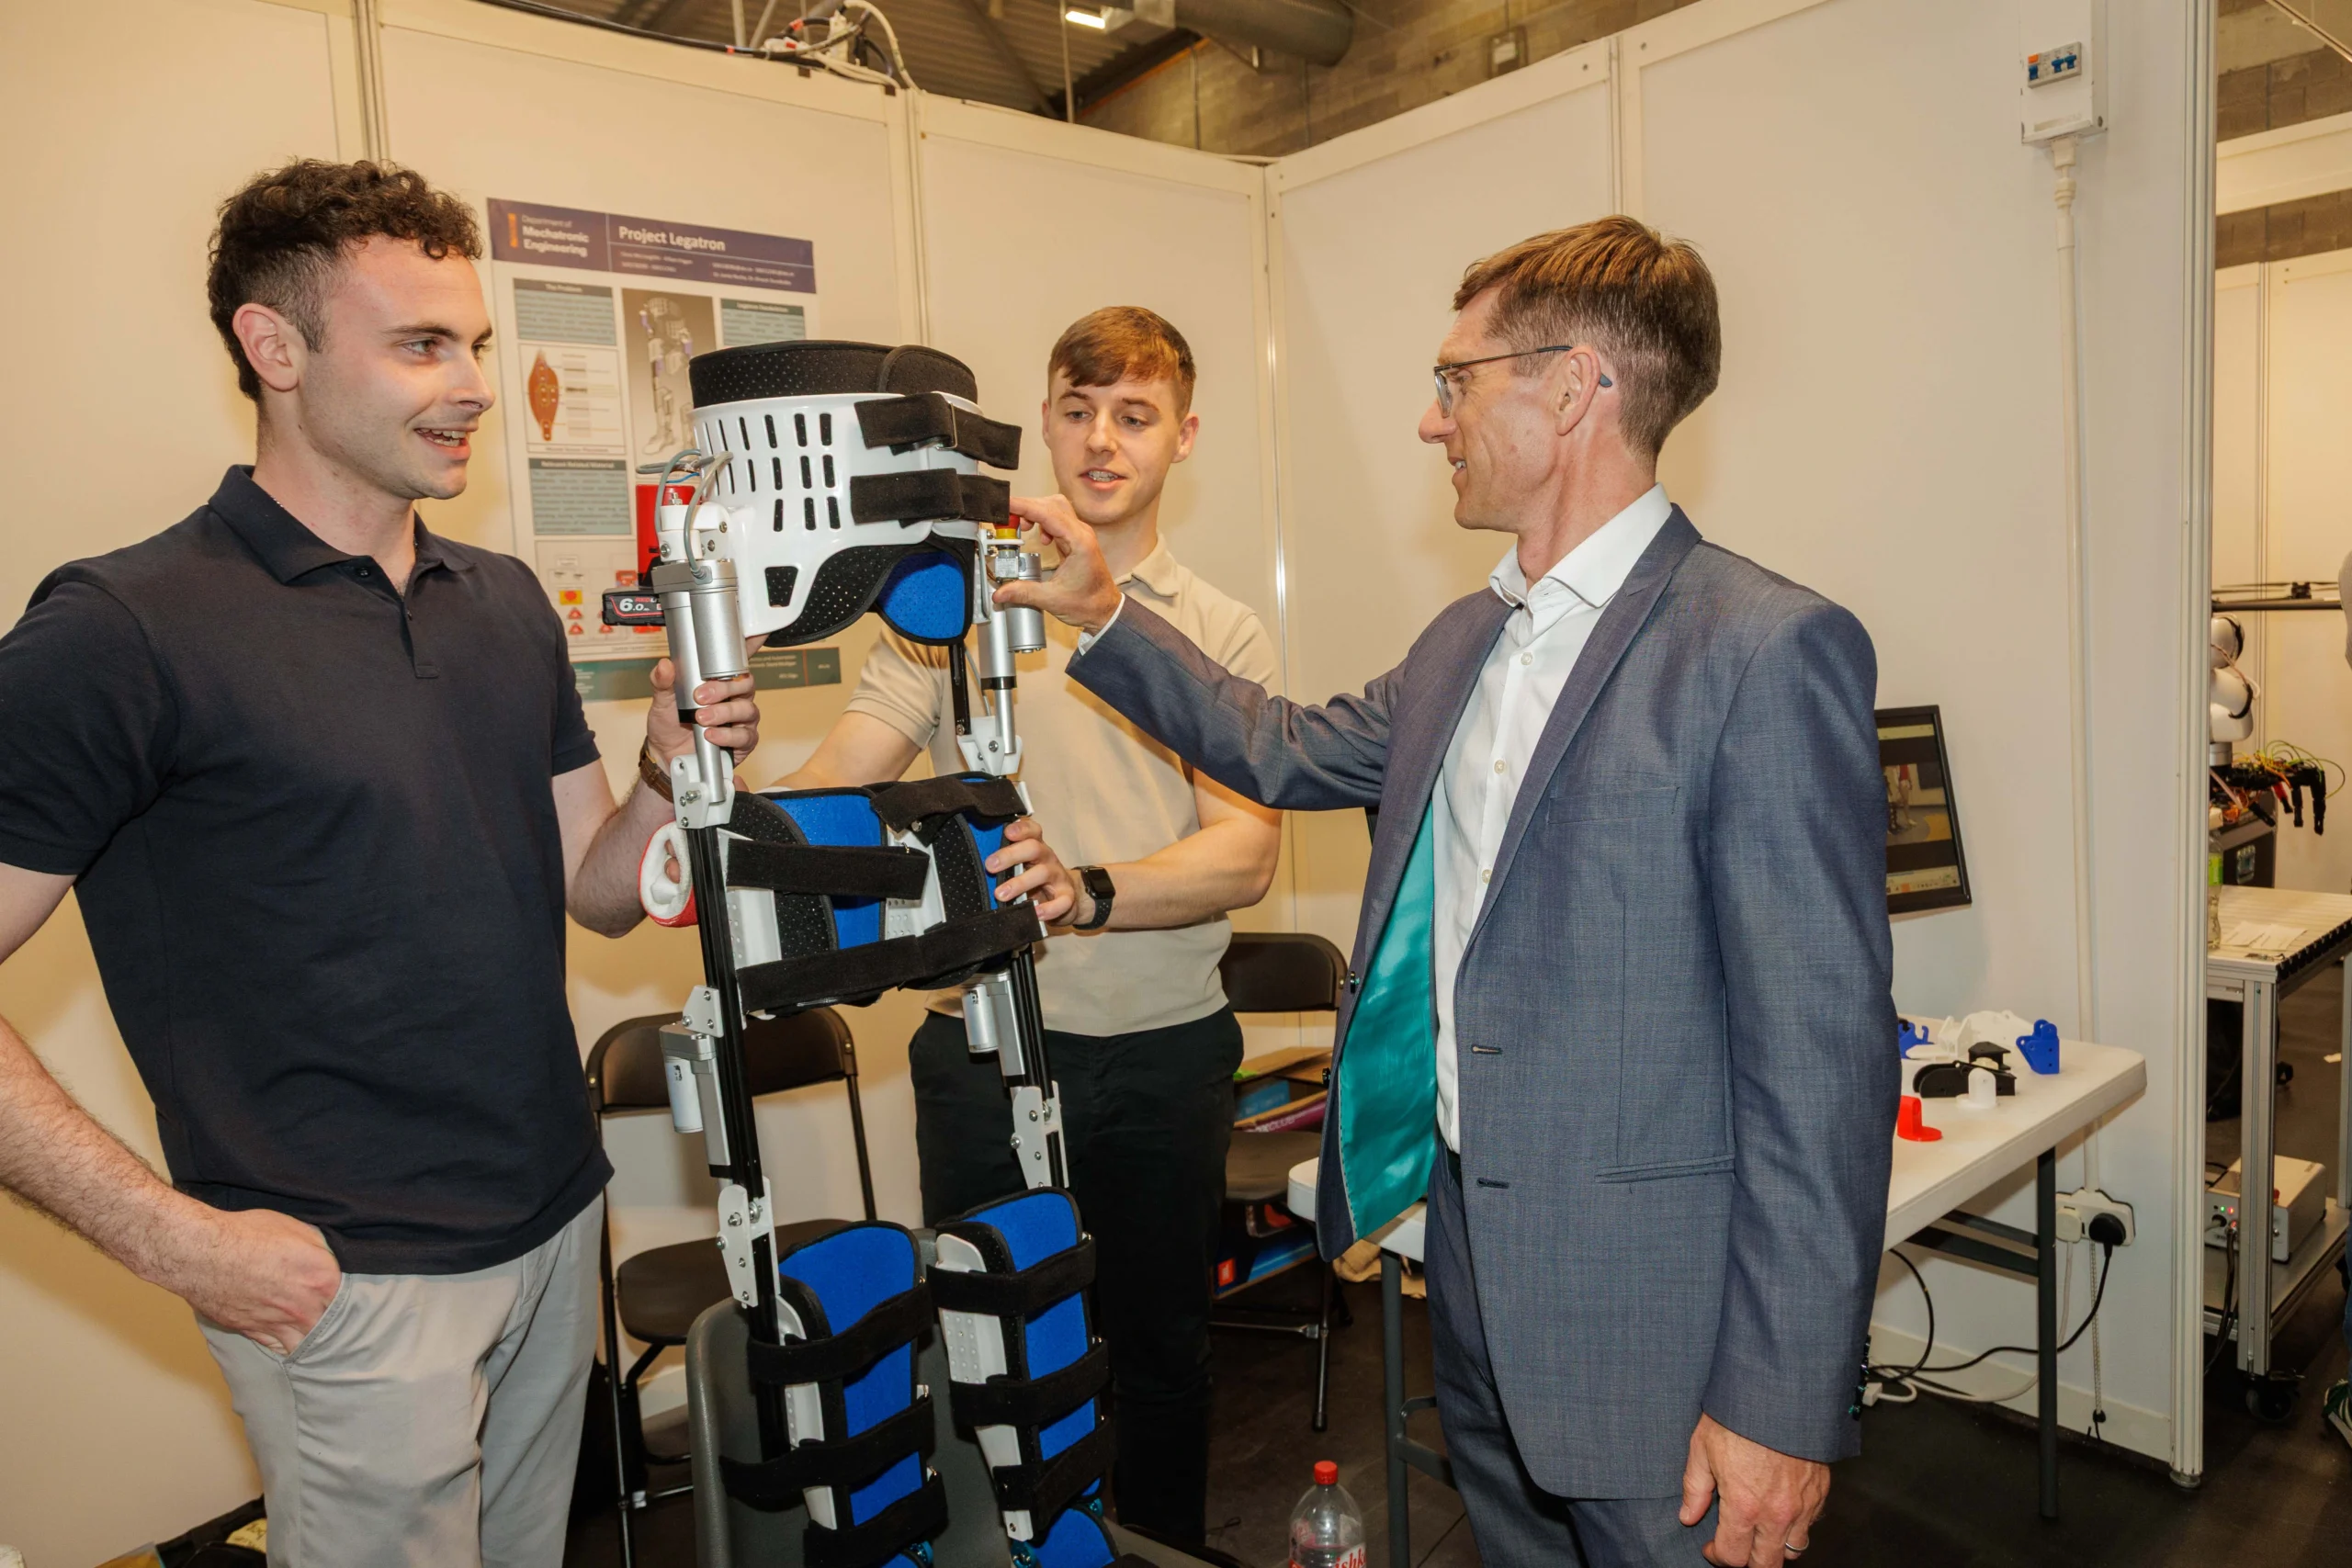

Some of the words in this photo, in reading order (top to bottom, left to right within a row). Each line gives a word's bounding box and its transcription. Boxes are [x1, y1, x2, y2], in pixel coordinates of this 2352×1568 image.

[523, 238, 588, 258] Engineering
[618, 226, 668, 244] Project
[669, 231, 726, 252] Legatron
